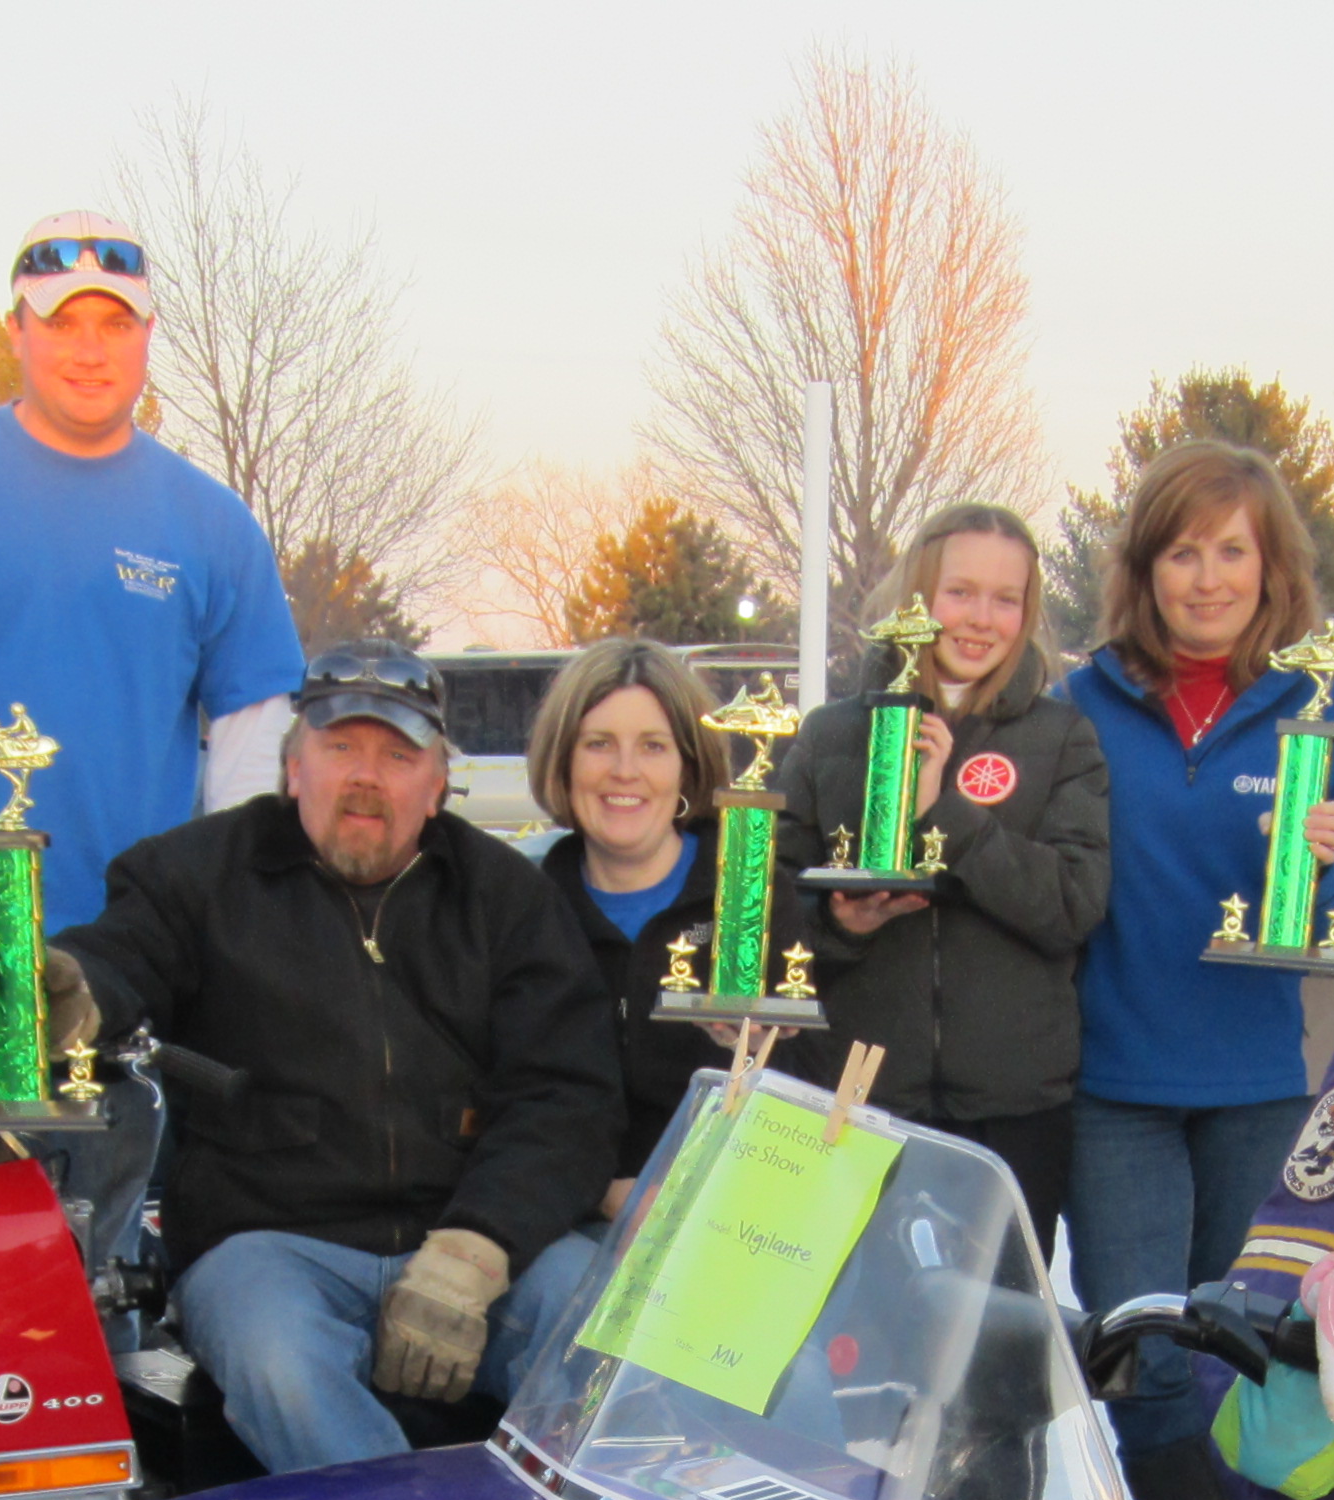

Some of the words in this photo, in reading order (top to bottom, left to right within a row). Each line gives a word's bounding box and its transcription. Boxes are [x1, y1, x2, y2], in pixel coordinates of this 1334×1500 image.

[758, 1144, 806, 1177] Show
[738, 1220, 812, 1262] Vigilante
[710, 1343, 744, 1369] MN
[41, 1393, 105, 1410] 400
